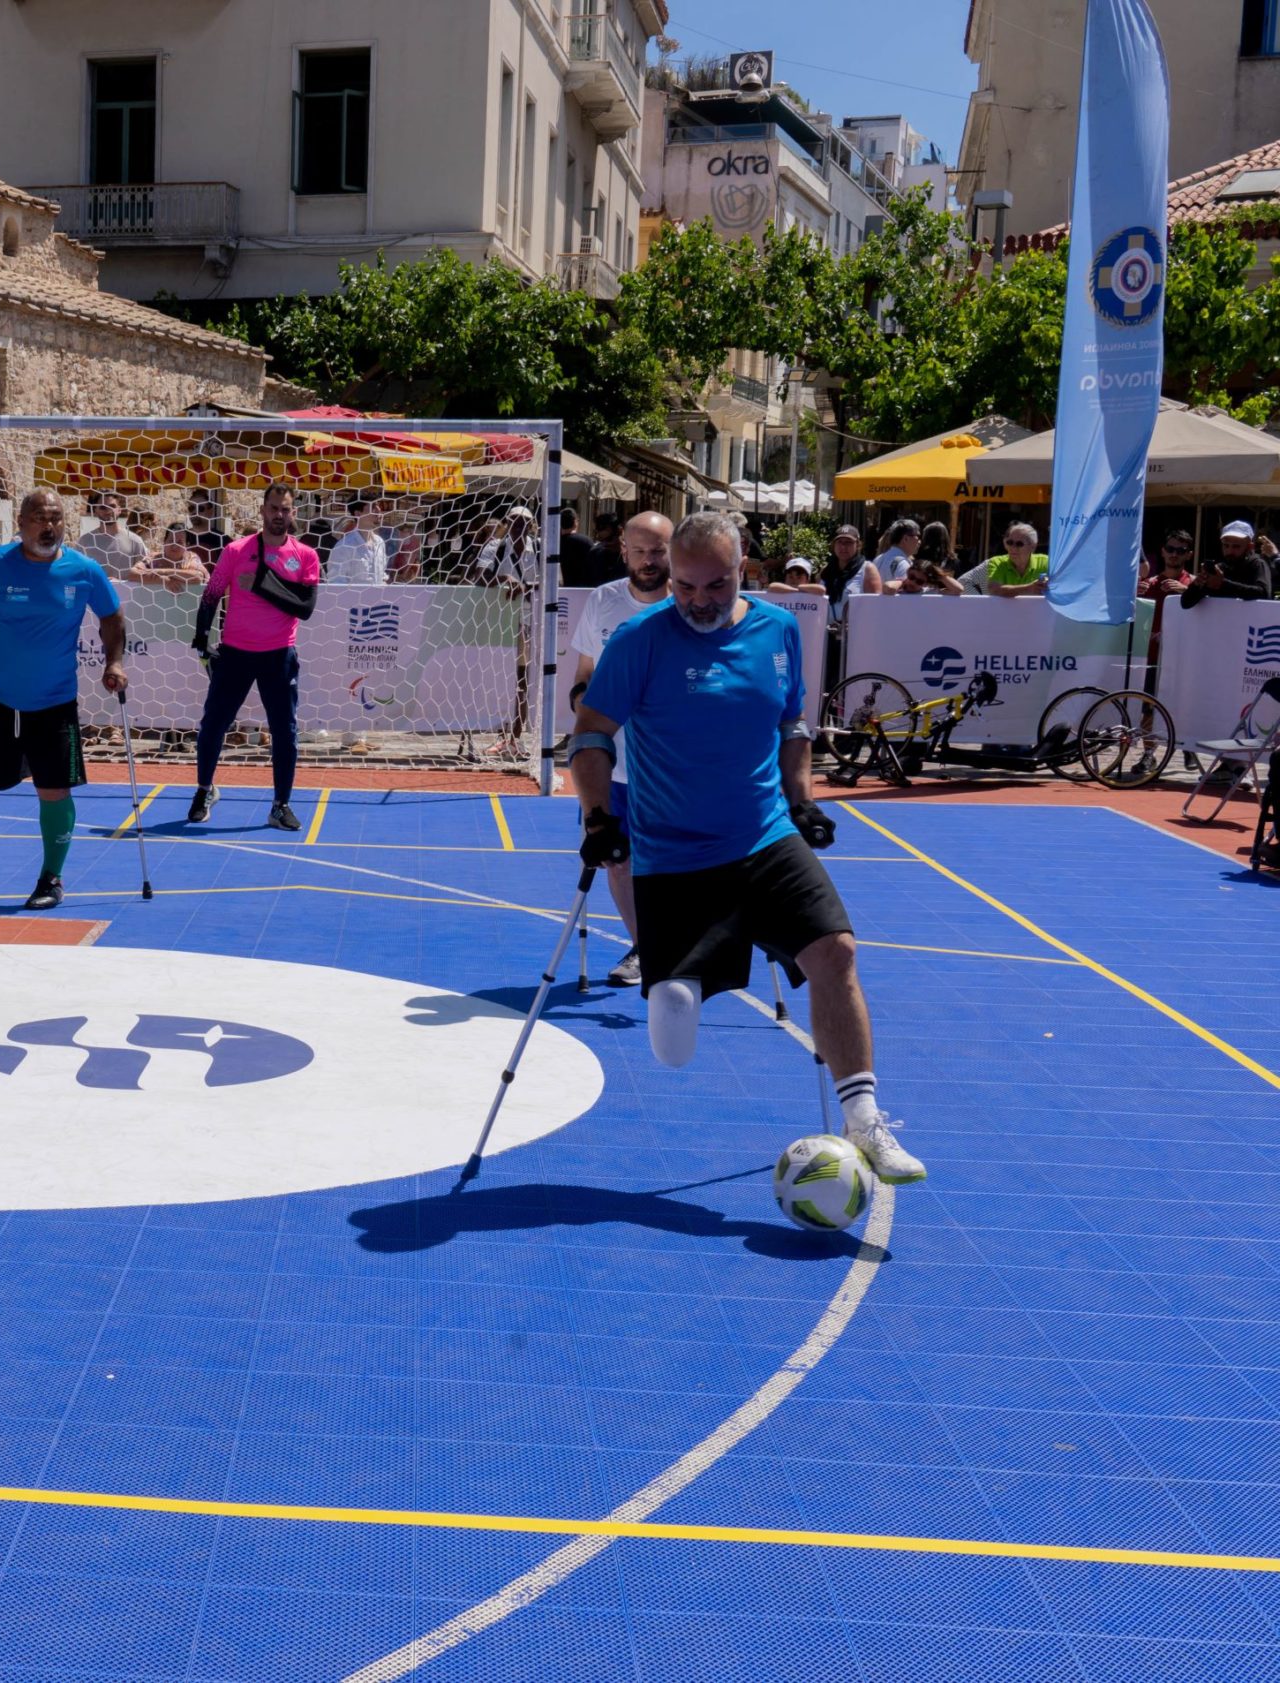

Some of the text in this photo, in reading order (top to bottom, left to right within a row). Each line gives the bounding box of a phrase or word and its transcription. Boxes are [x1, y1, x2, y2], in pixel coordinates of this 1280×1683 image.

[707, 149, 769, 176] okra
[954, 482, 1004, 498] ATM
[974, 655, 1078, 671] HELLENiQ
